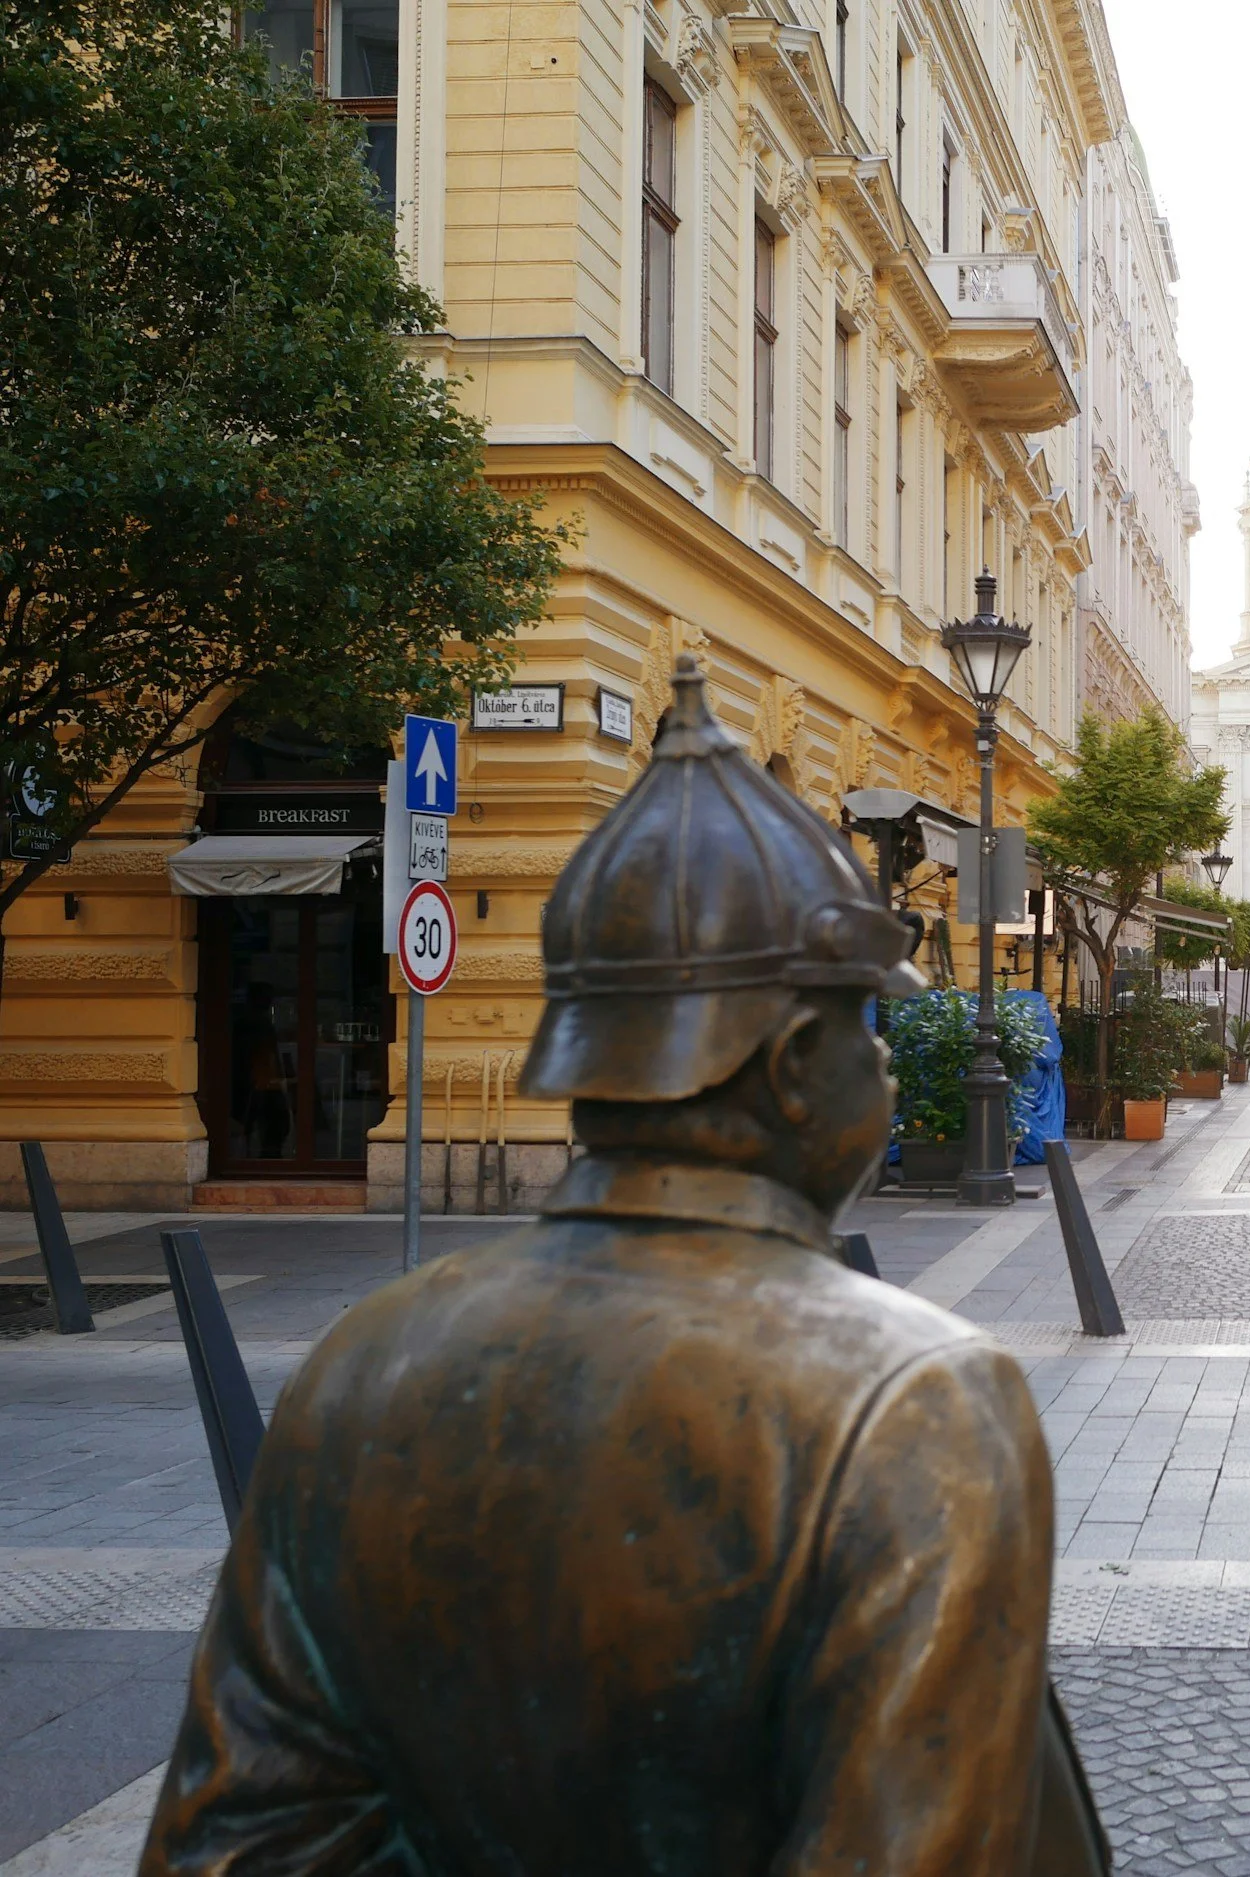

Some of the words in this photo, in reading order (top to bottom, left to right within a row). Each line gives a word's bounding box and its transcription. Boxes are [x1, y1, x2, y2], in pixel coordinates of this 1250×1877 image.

[479, 699, 517, 713] Október
[522, 698, 531, 713] 6.
[414, 916, 441, 959] 30
